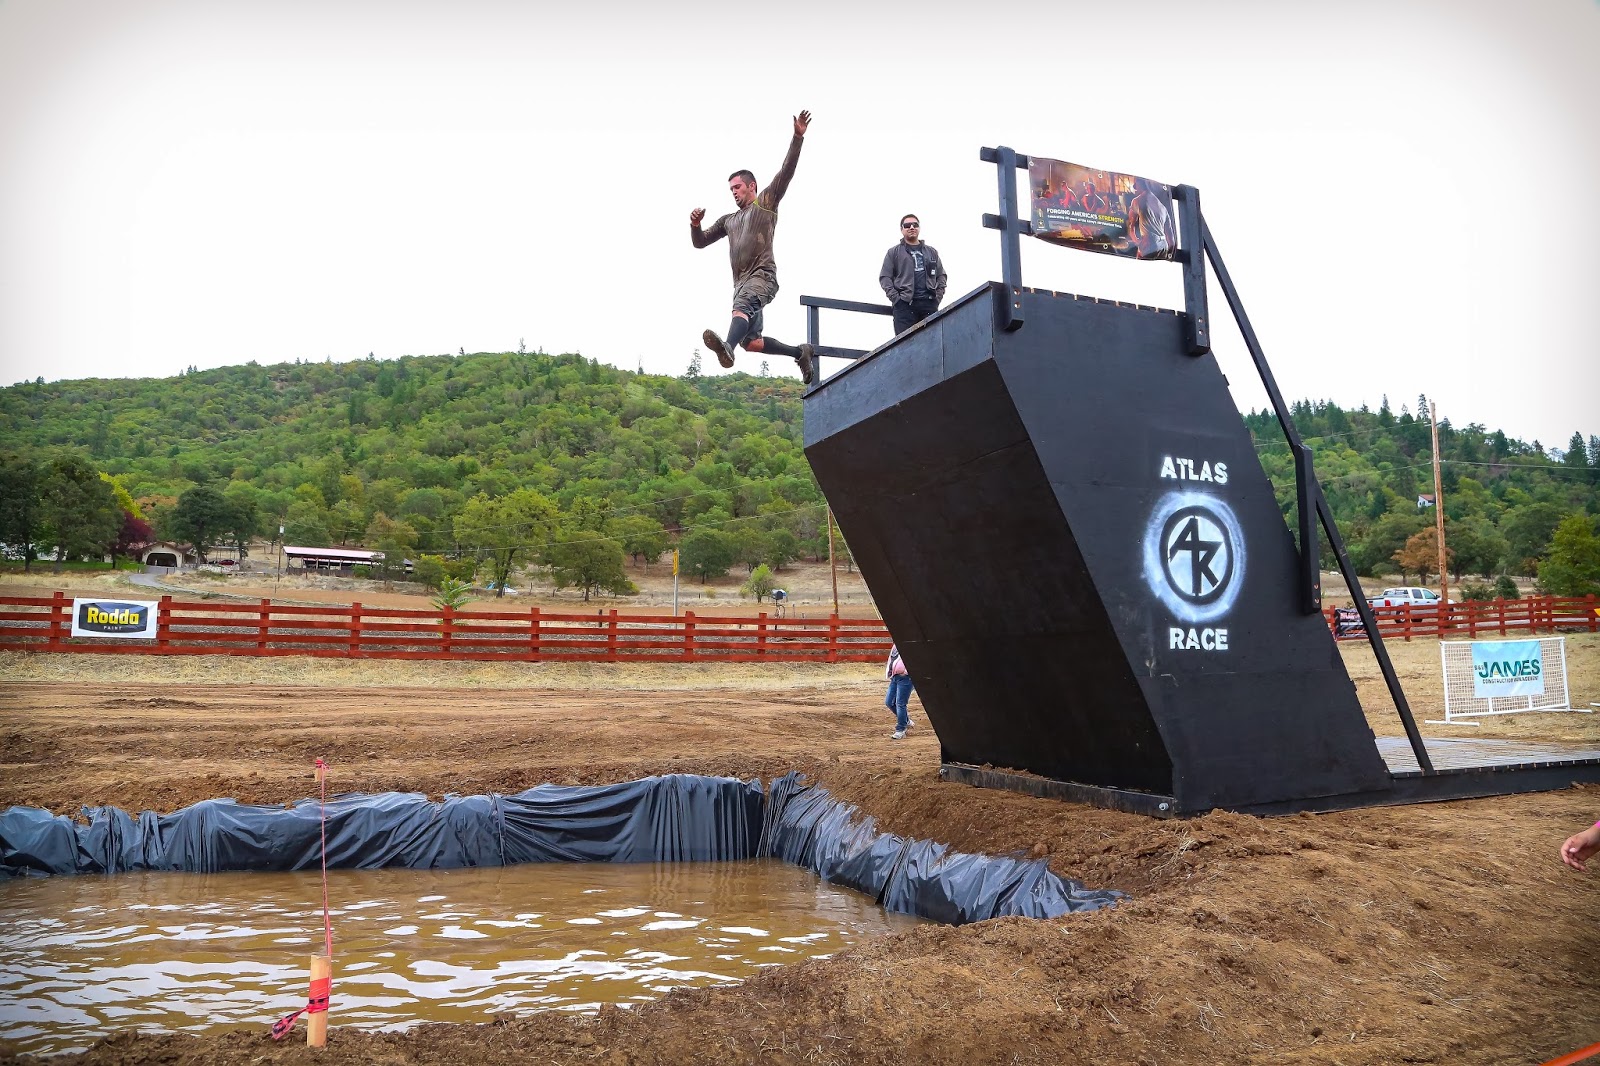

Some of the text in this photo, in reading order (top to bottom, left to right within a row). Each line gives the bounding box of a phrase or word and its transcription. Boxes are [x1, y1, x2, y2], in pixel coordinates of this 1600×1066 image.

[1071, 211, 1098, 220] AMERICA'S
[1098, 215, 1124, 223] STRENGTH
[1160, 456, 1228, 484] ATLAS
[87, 607, 140, 625] Rodda
[1169, 627, 1229, 651] RACE
[1478, 659, 1541, 678] JAMES
